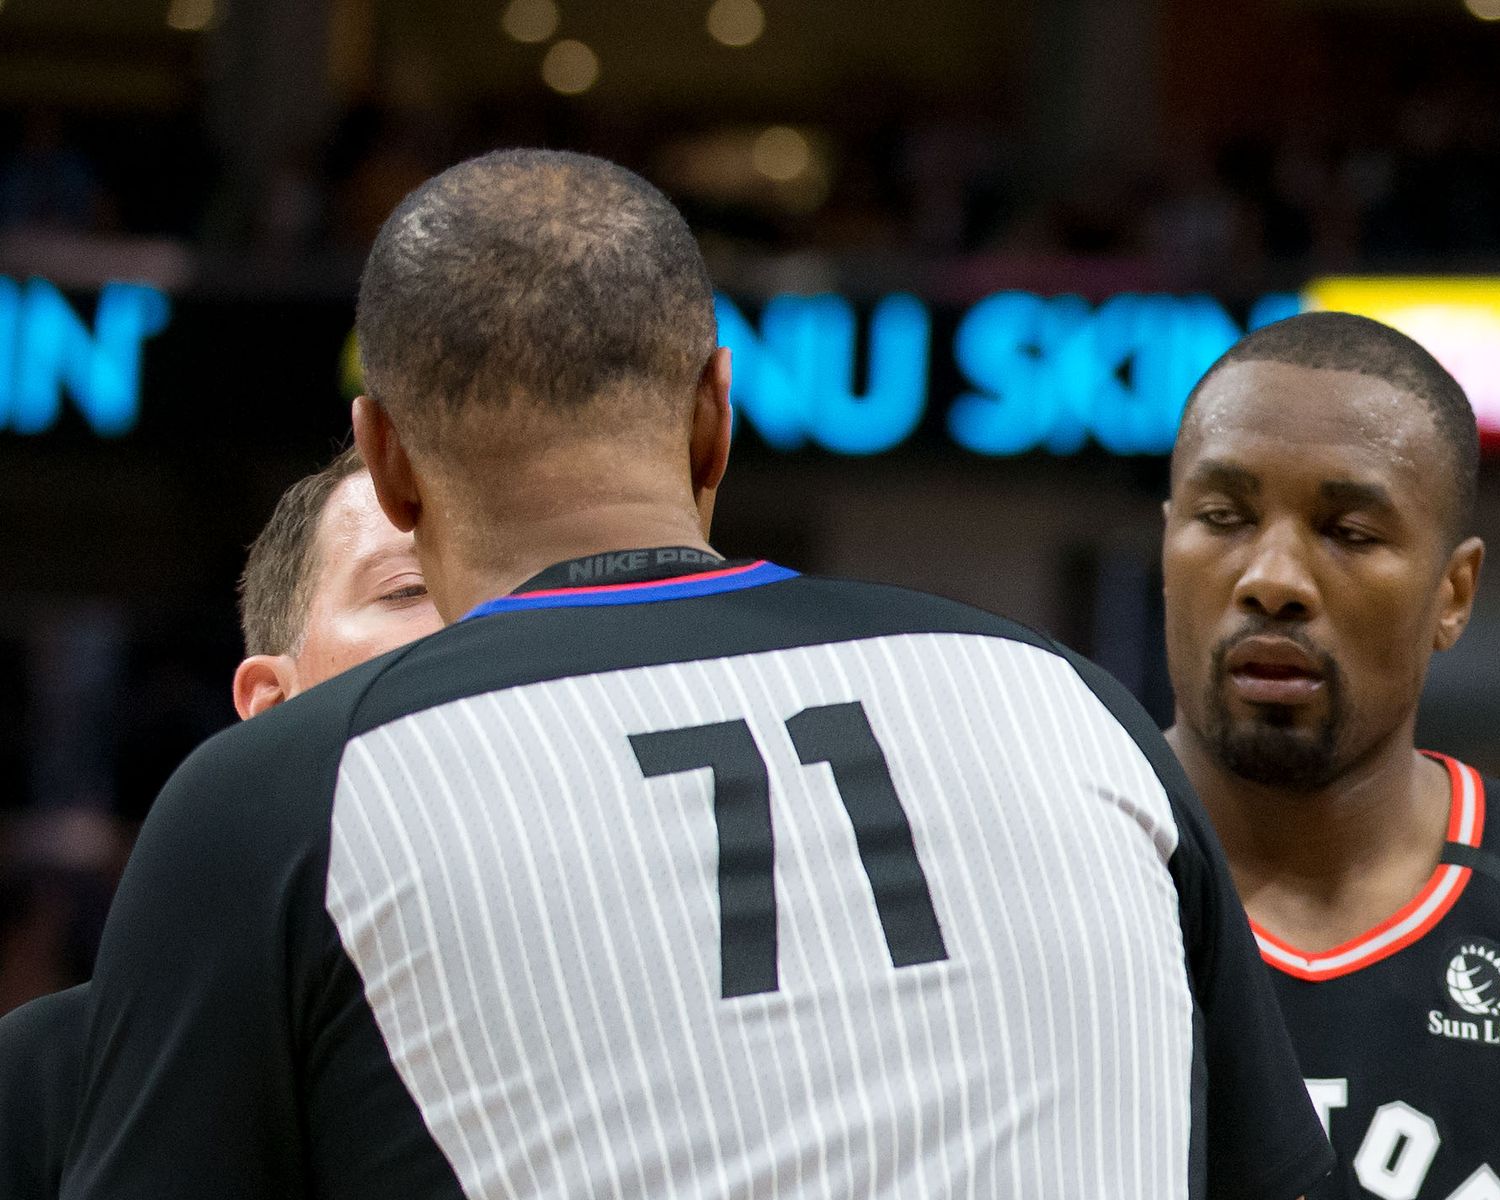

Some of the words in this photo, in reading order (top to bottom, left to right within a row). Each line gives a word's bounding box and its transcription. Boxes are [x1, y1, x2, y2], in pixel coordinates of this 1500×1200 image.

[568, 552, 649, 582] NIKE
[627, 700, 949, 999] 71
[1428, 1009, 1479, 1041] Sun
